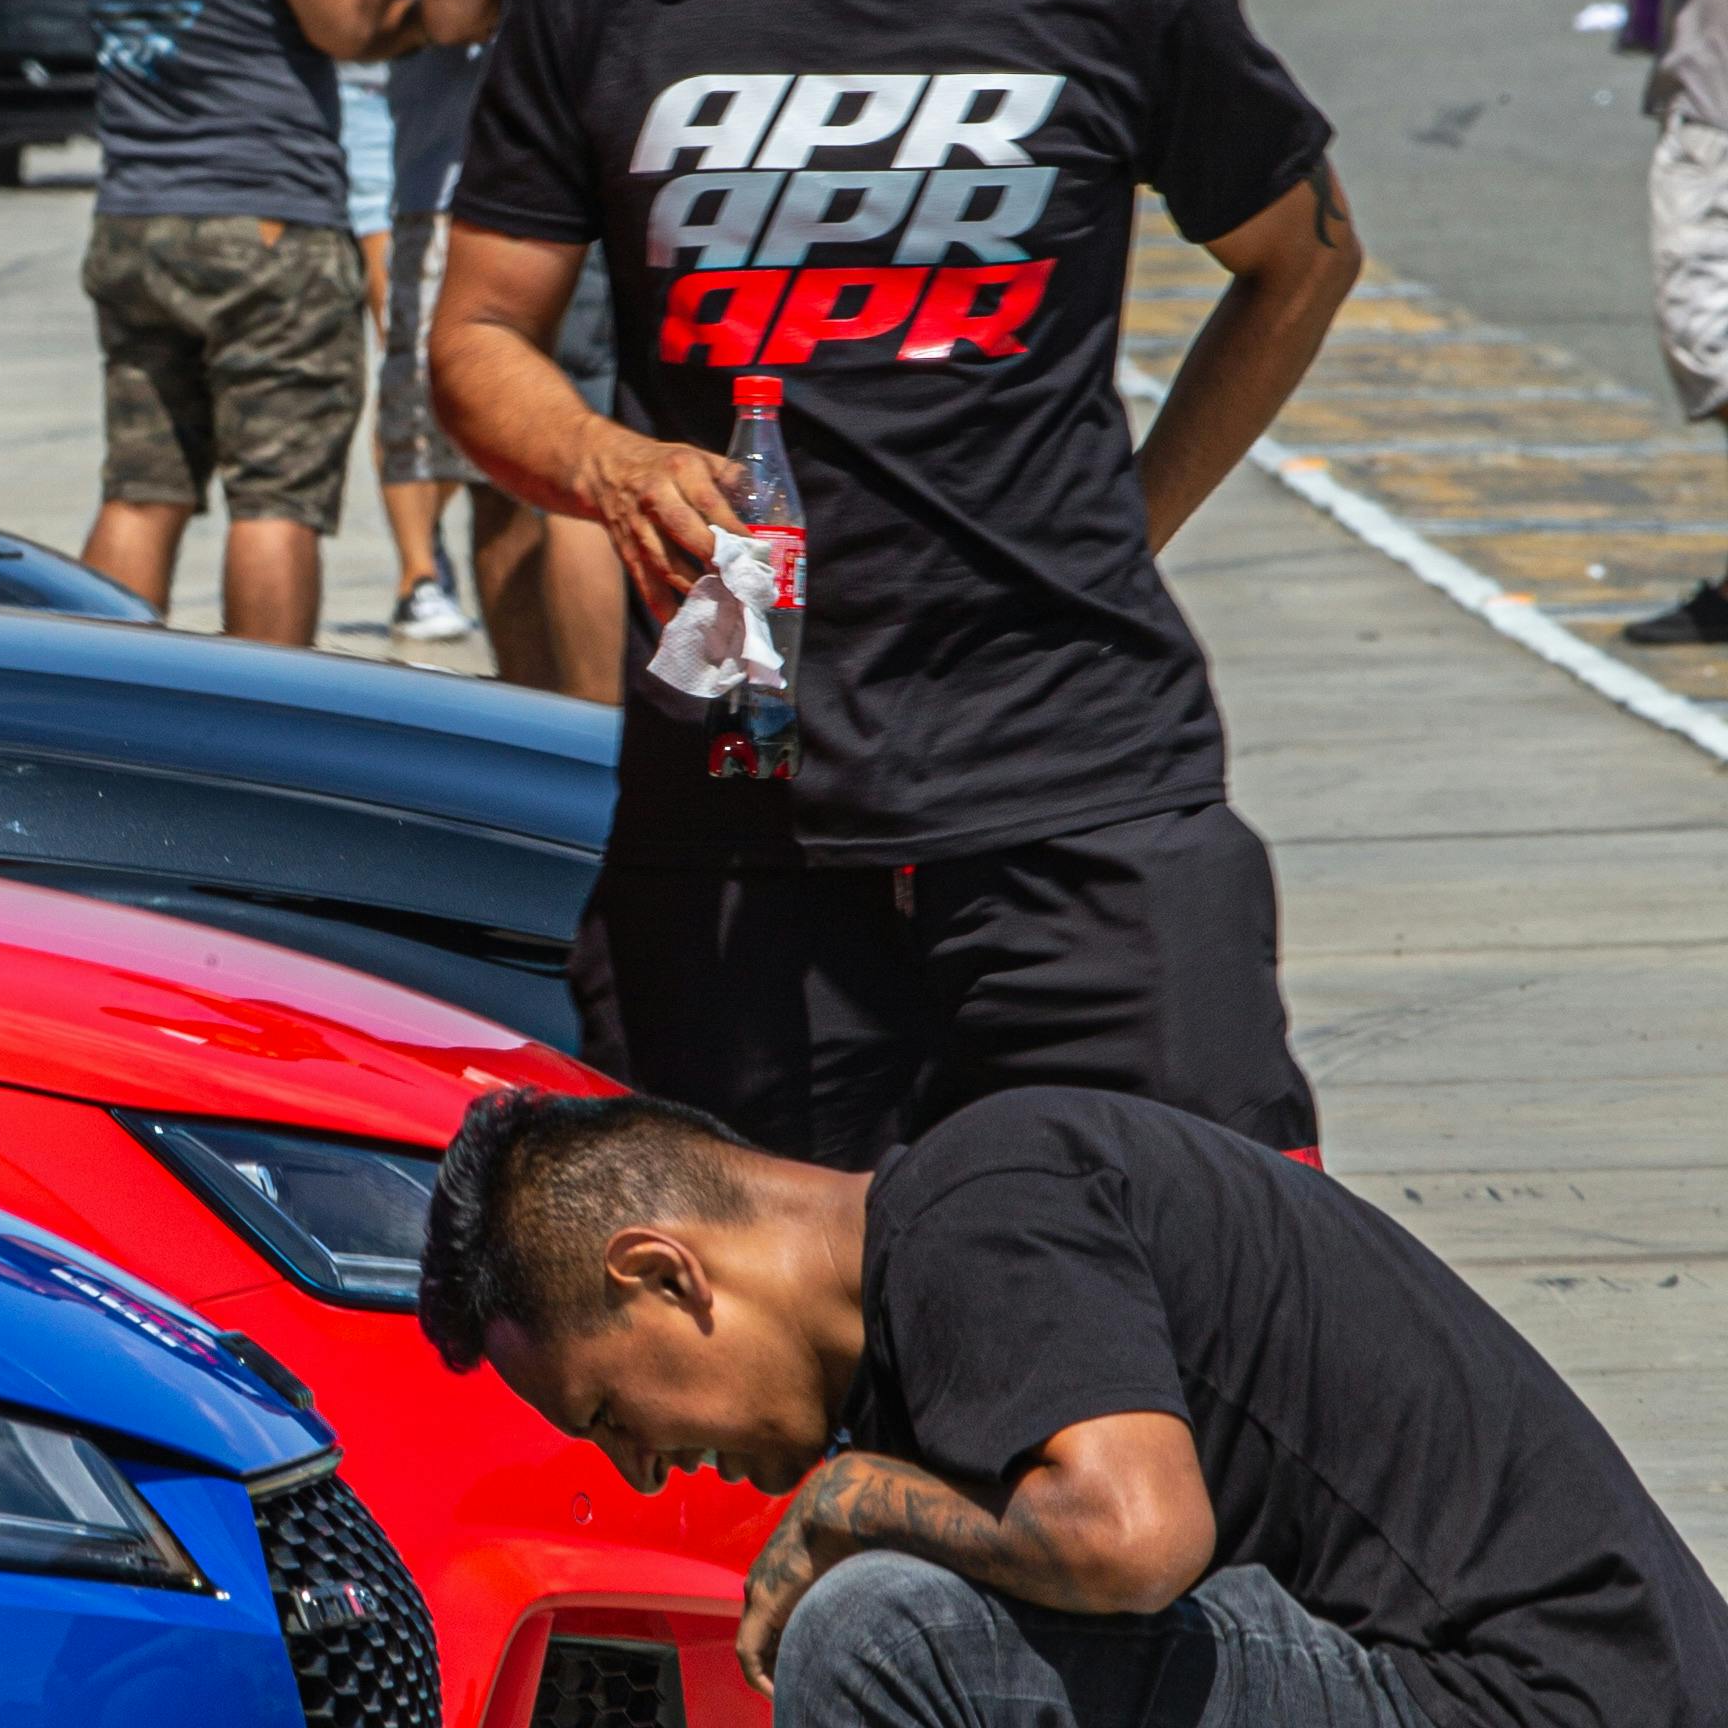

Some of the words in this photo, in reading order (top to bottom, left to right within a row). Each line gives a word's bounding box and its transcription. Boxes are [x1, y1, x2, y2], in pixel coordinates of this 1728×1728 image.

[629, 73, 1068, 173] APR
[646, 167, 1060, 270] APR
[660, 258, 1059, 367] APR
